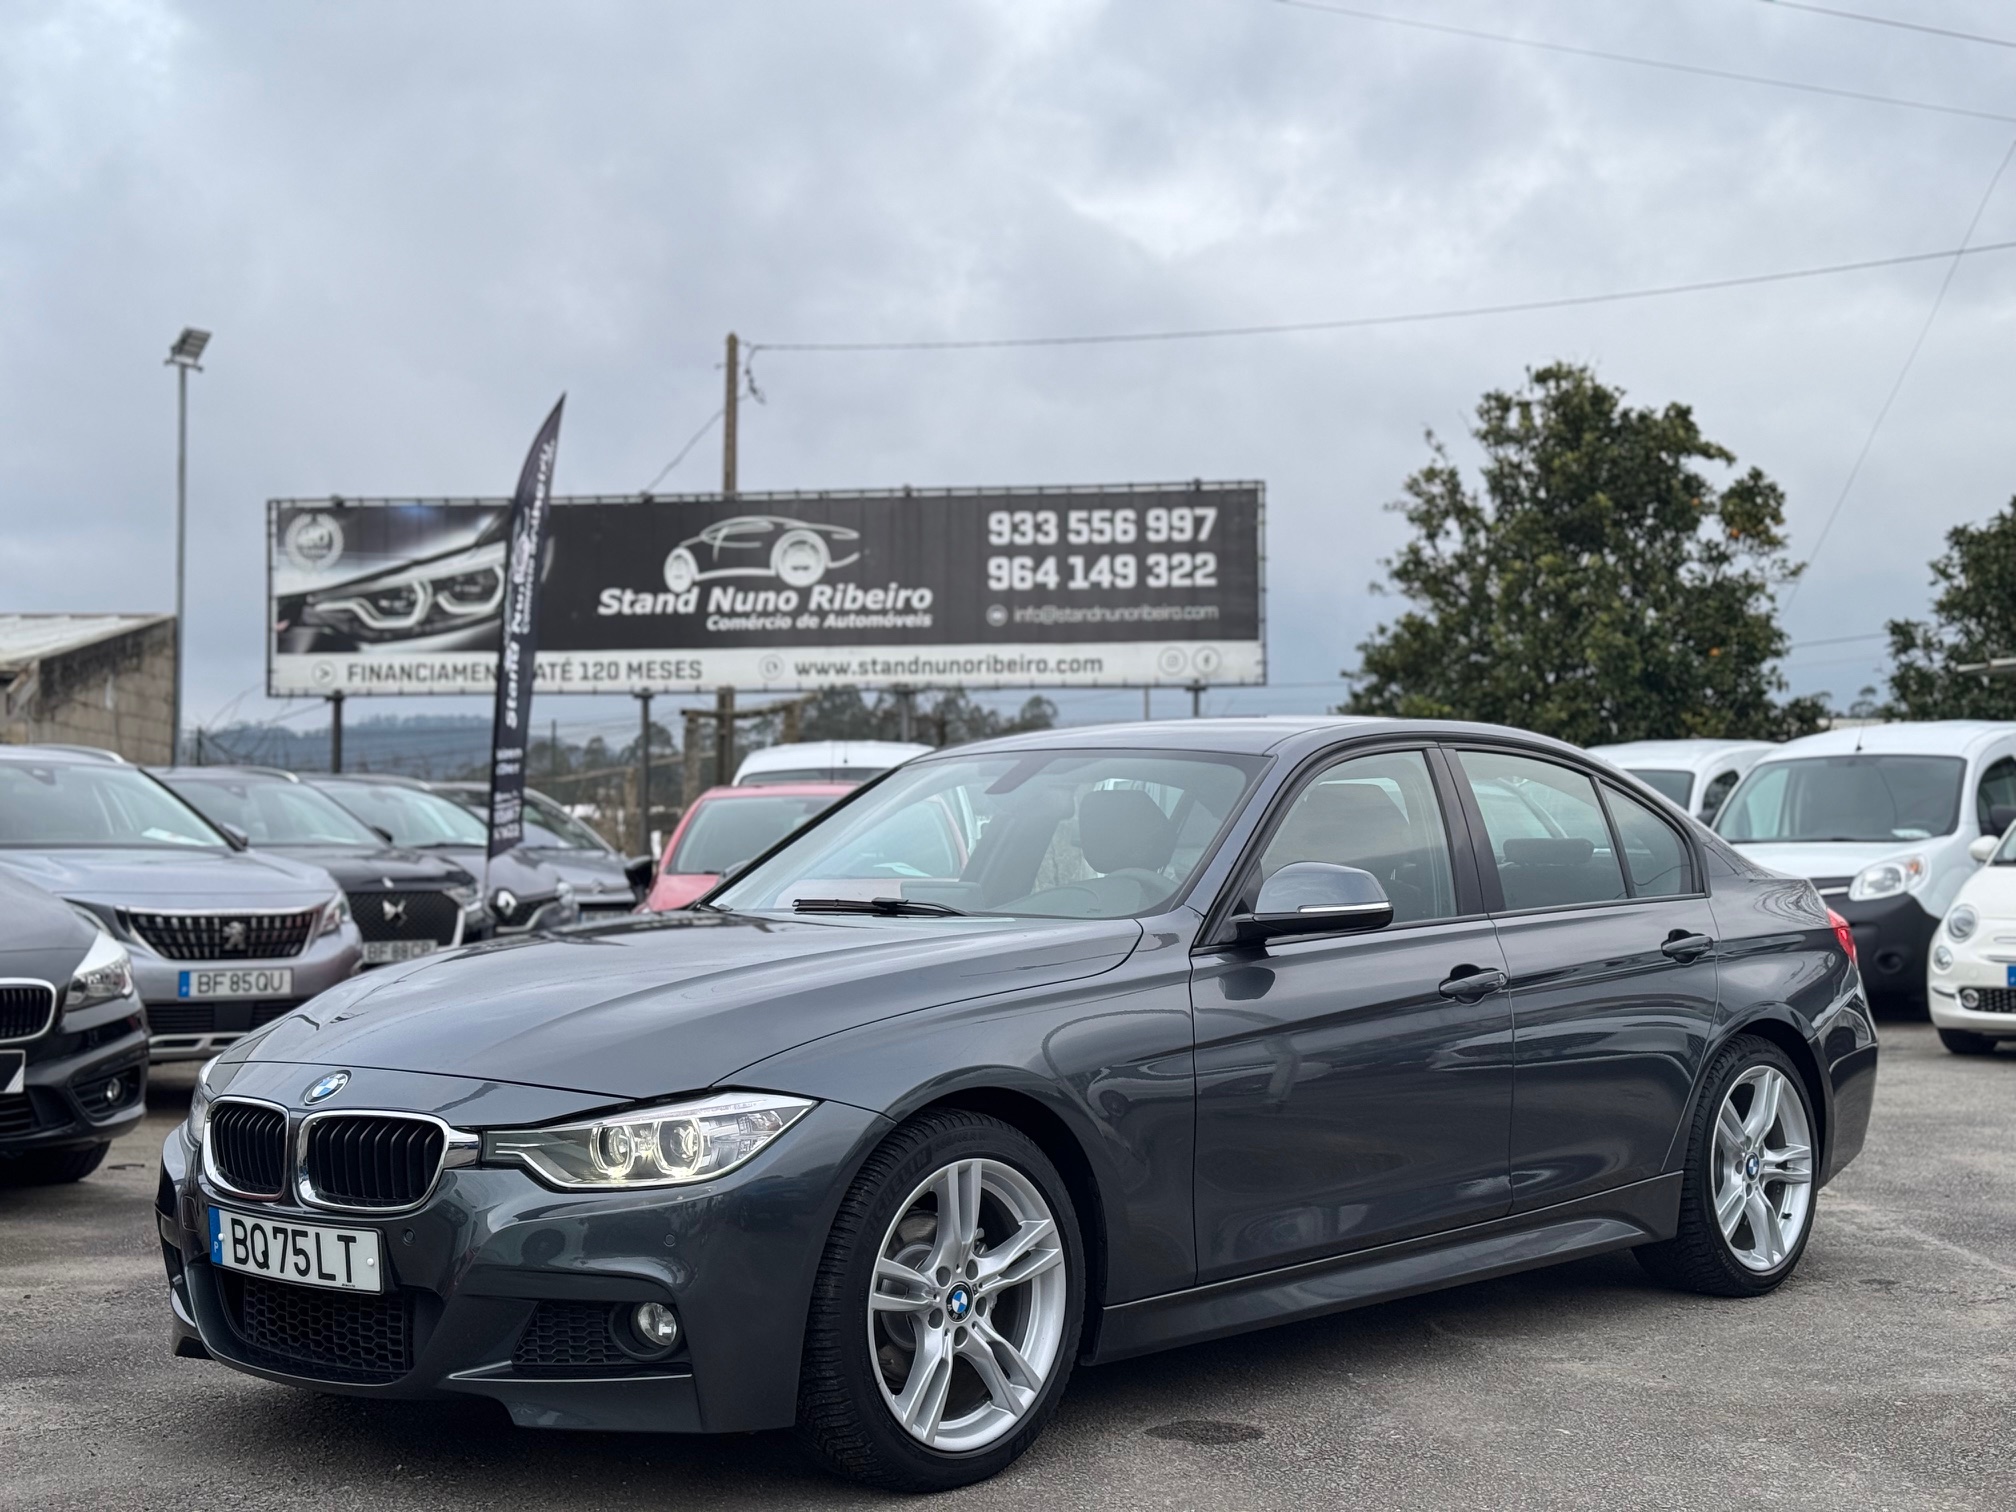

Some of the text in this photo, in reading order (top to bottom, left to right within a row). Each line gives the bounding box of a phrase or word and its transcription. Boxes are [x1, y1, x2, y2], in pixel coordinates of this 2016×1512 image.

[988, 507, 1218, 545] 933 556 997
[987, 552, 1218, 590] 964 149 322
[597, 582, 934, 615] Stand Nuno Ribeiro
[706, 610, 933, 631] Comércio de Automóveis
[1013, 604, 1219, 625] info@standnunoribeiro.com
[347, 658, 703, 683] FINANCIAMEN ATÉ 120 MESES
[794, 654, 1104, 677] www.standnunoribeiro.com
[213, 1240, 219, 1253] P
